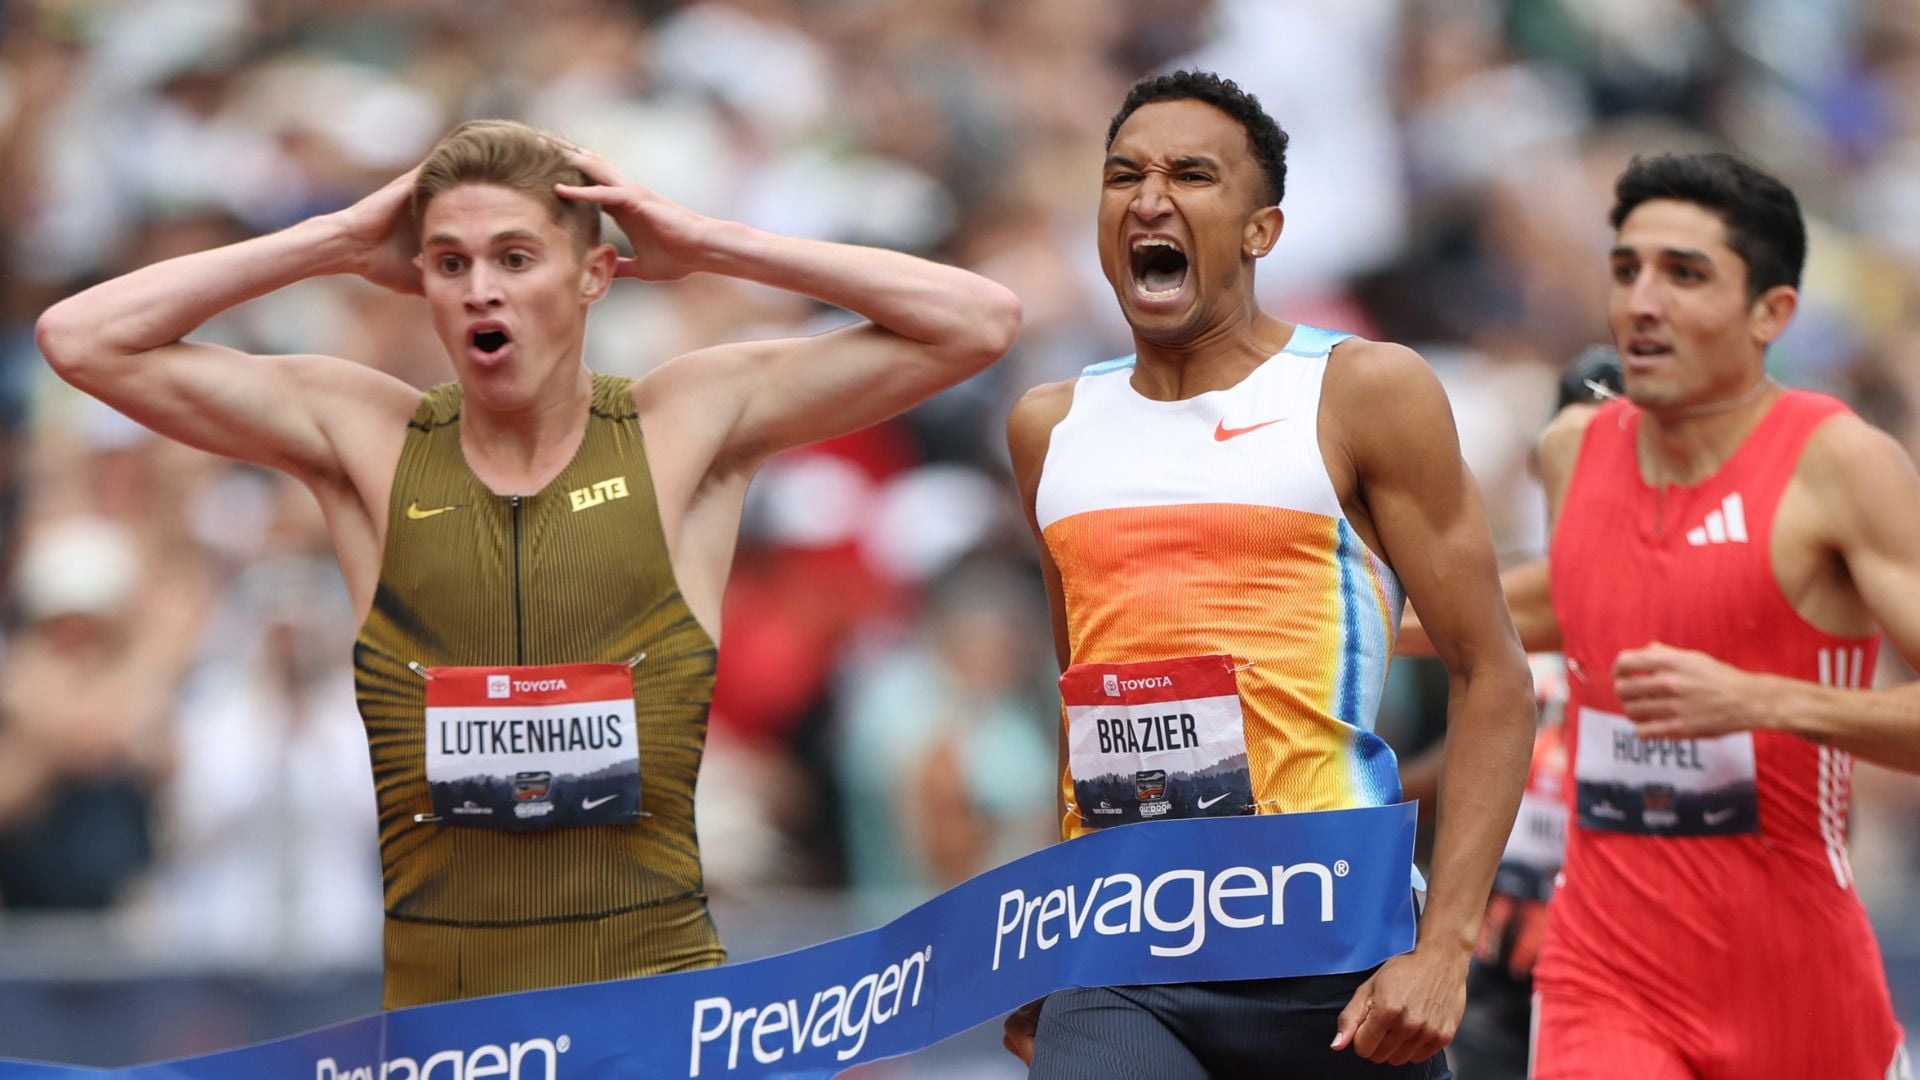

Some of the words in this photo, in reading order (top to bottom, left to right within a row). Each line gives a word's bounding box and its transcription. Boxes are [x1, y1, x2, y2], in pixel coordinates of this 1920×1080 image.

[512, 679, 567, 692] TOYOTA
[1119, 676, 1173, 691] TOYOTA
[441, 714, 623, 755] LUTKENHAUS
[1097, 713, 1199, 754] BRAZIER
[1613, 728, 1706, 770] HOPPEL
